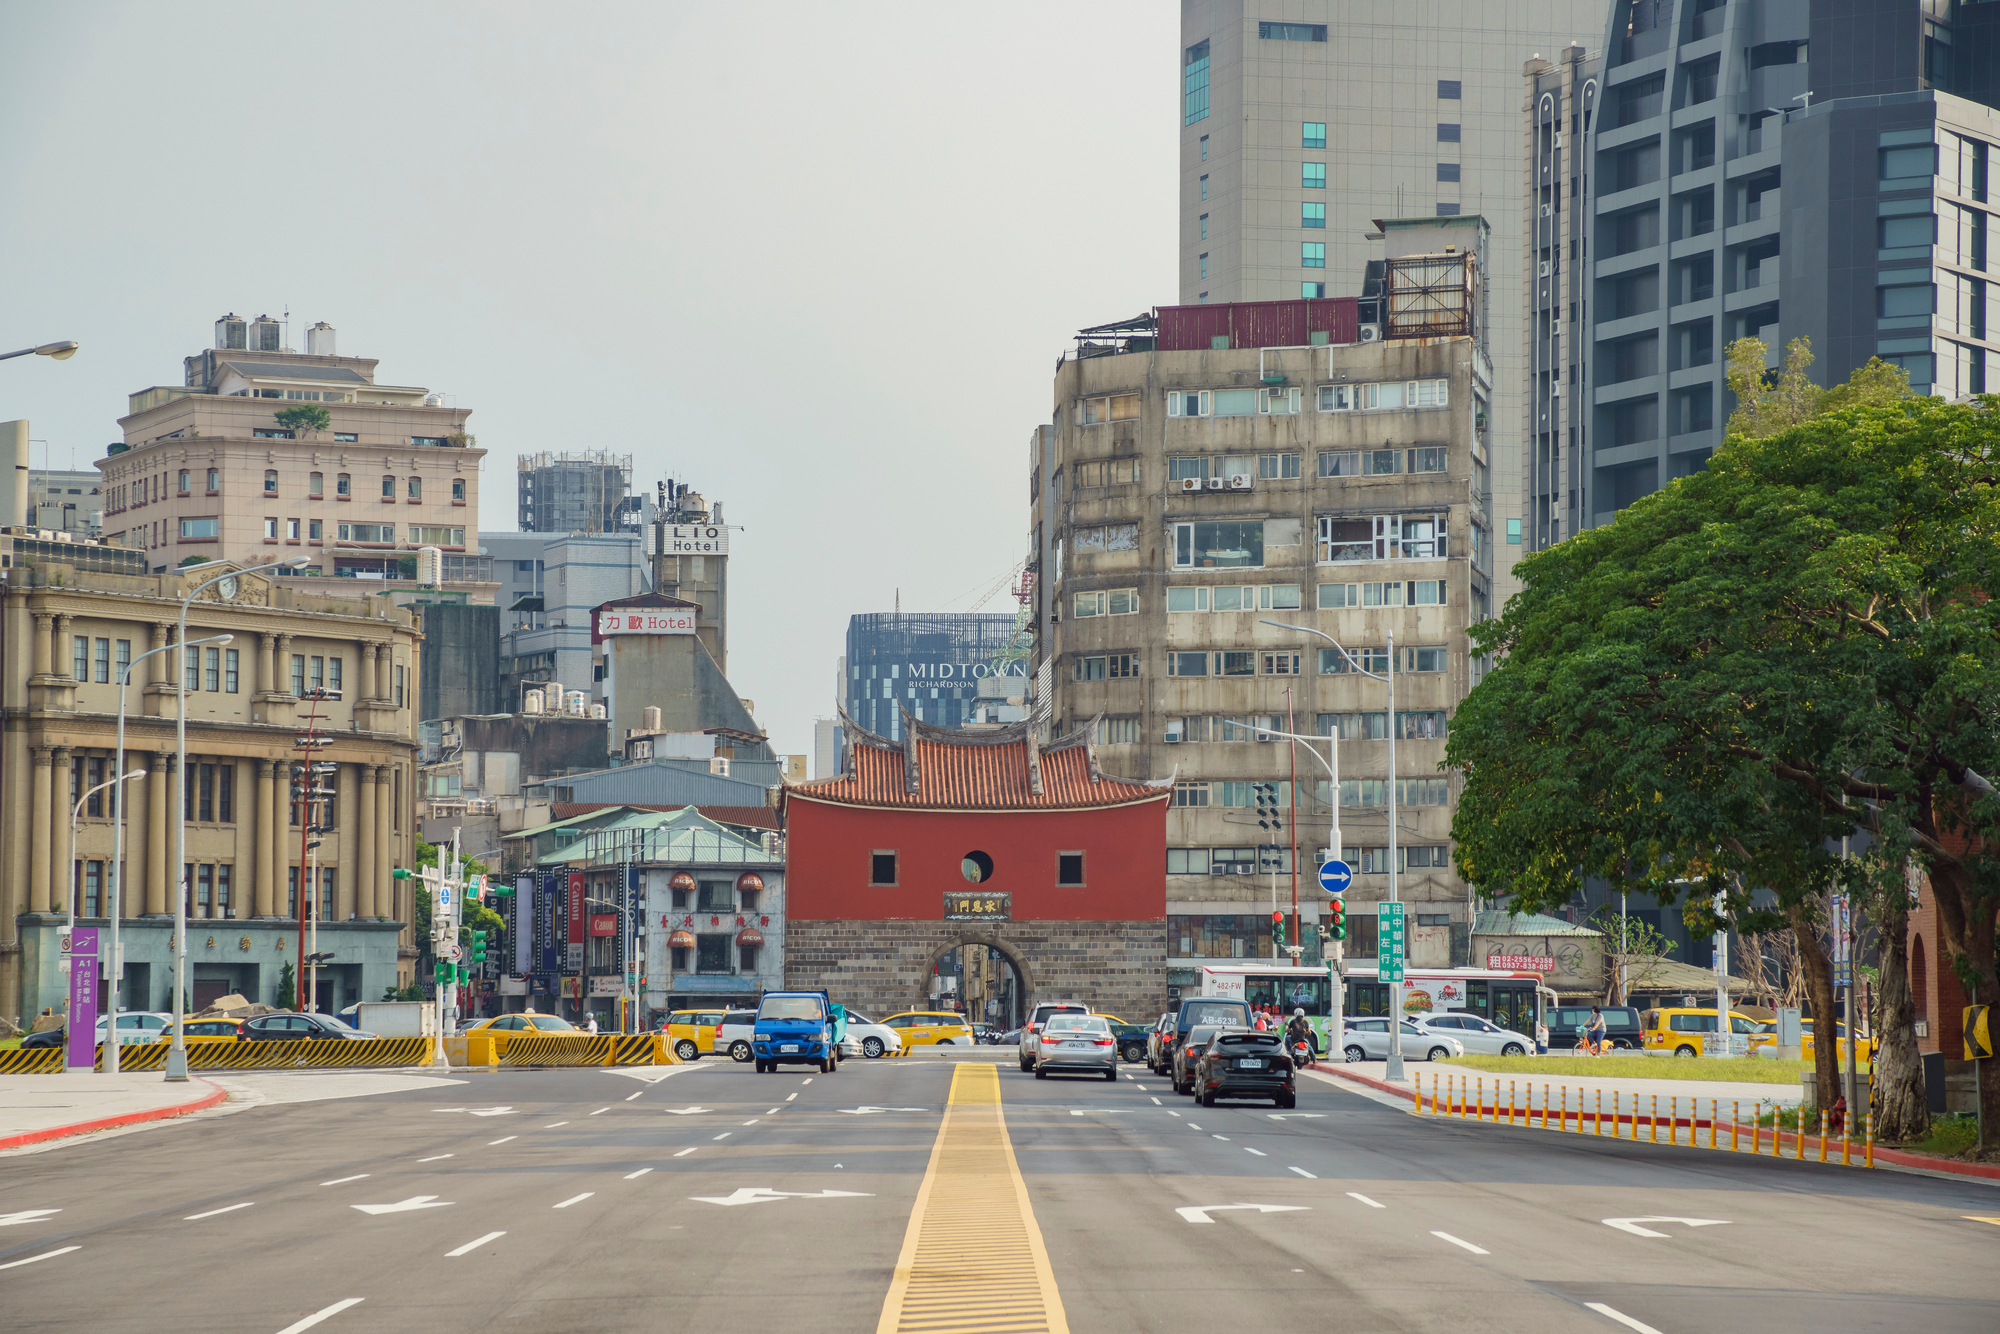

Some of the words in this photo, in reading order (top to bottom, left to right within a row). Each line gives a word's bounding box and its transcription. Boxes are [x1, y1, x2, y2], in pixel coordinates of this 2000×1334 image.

[673, 527, 719, 538] LIO
[673, 540, 719, 552] Hotel
[606, 615, 643, 630] 力歐
[648, 616, 694, 630] Hotel
[908, 663, 1026, 679] MIDTOWN
[908, 680, 974, 688] RICHARDSON
[572, 882, 581, 920] Canon
[544, 892, 552, 949] OLYMPUS
[594, 919, 614, 930] Canon
[169, 931, 286, 953] 北郵局
[1380, 904, 1390, 981] 請靠左行駛
[1392, 904, 1402, 981] 往中華路汽車
[78, 960, 91, 968] A1
[1490, 956, 1501, 968] 租
[1502, 956, 1553, 964] 02-2556-0358
[1502, 962, 1553, 970] 0937-838-057
[83, 970, 91, 1004] 台北車站
[1202, 1016, 1237, 1025] AB-6238
